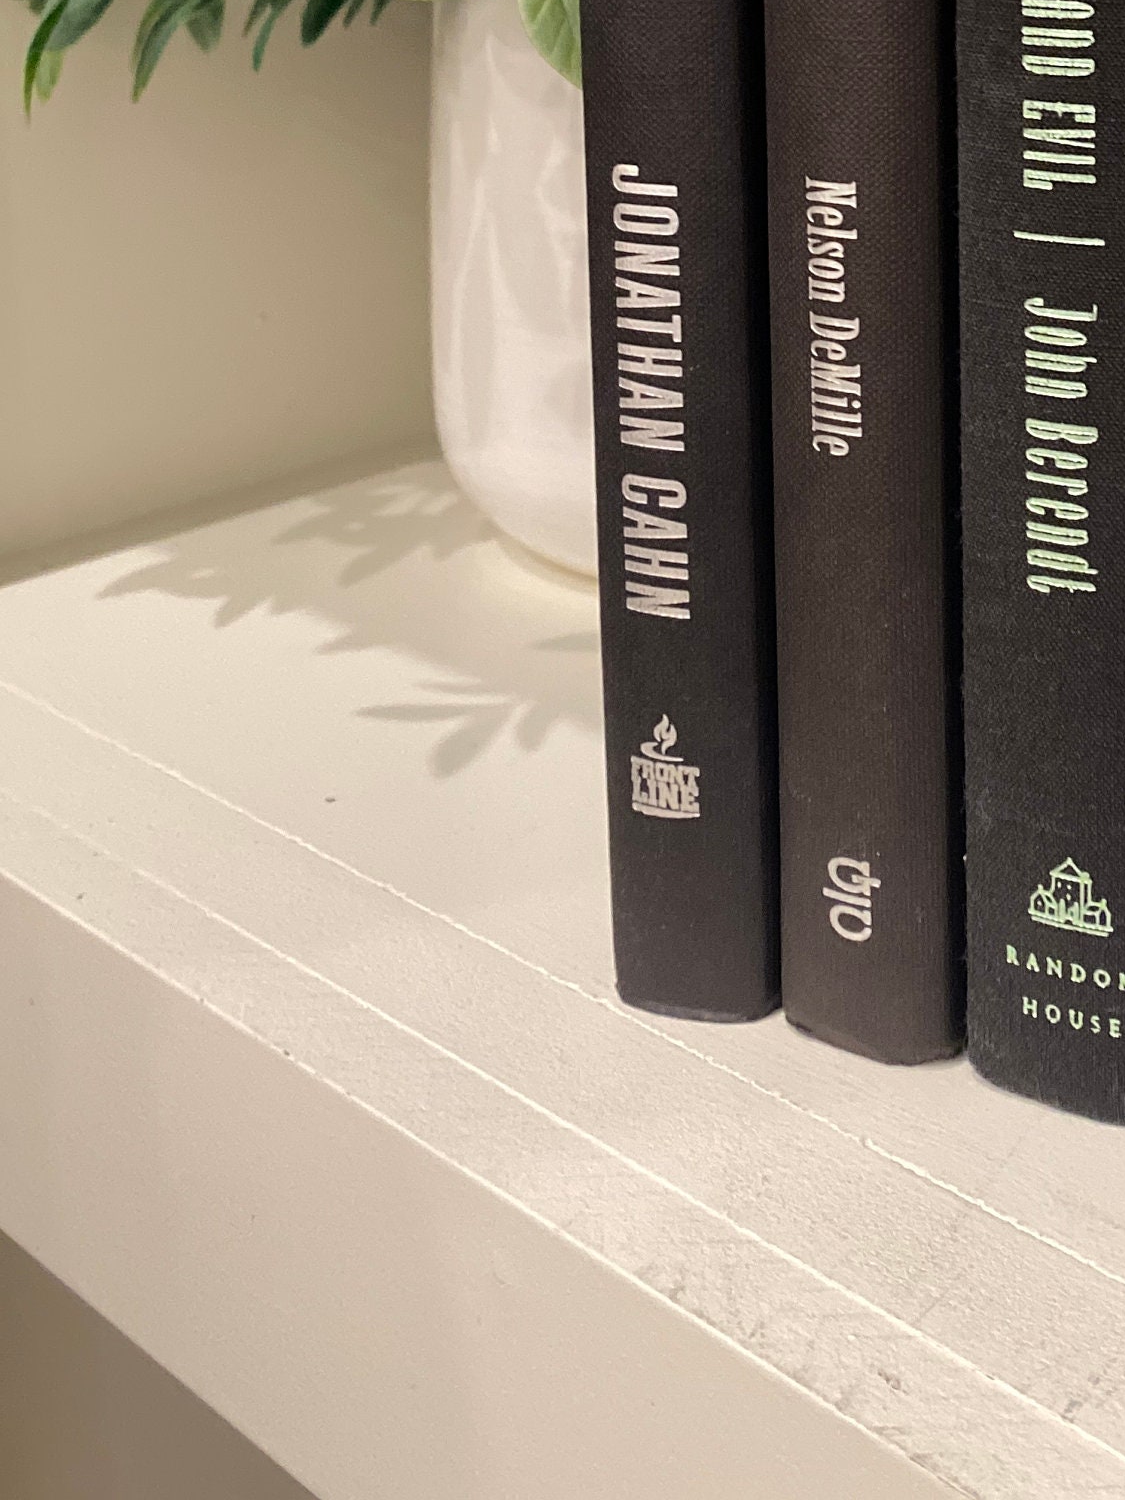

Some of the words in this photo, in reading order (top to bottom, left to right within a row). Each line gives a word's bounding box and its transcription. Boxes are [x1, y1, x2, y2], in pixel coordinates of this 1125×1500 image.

[1022, 99, 1097, 191] EVIL
[805, 175, 858, 303] Nelson
[611, 163, 685, 452] JONATHAN
[1023, 297, 1098, 400] John
[809, 310, 863, 457] DeMille
[621, 473, 691, 620] CAHN
[1025, 417, 1099, 594] Berendt
[632, 779, 700, 812] LINE
[1022, 996, 1122, 1038] HOUSE
